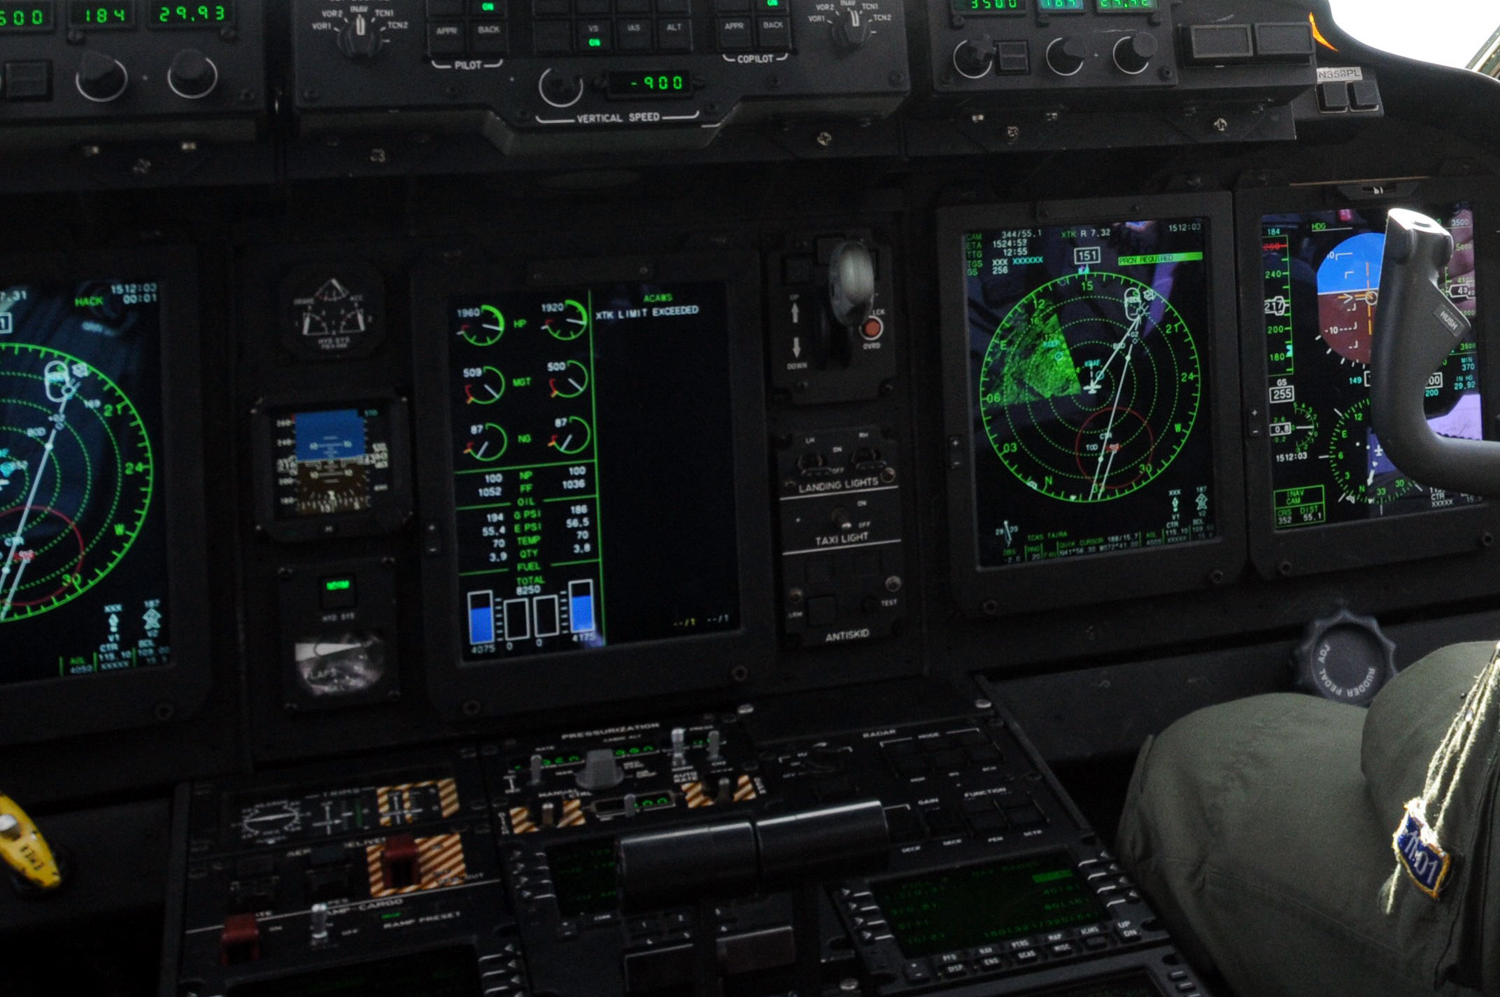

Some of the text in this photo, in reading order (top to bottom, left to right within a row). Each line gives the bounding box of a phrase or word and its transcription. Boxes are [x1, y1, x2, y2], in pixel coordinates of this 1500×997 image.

[86, 9, 125, 23] 184
[159, 6, 225, 22] 29.93
[737, 55, 773, 63] COPILOT
[454, 61, 482, 70] PILOT
[577, 112, 660, 123] VERTICAL SPEED
[1091, 229, 1110, 237] 7.32
[1079, 251, 1096, 260] 151
[1265, 270, 1281, 278] 240
[644, 294, 672, 303] ACAWS
[542, 303, 564, 312] 1920
[457, 309, 480, 318] 1960
[595, 305, 699, 320] XTK LIMIT EXCEEDED
[514, 319, 526, 328] HP
[1440, 310, 1459, 331] HUSH
[1267, 326, 1284, 334] 200
[1270, 353, 1285, 361] 180
[547, 362, 566, 372] 500
[463, 368, 482, 378] 509
[513, 377, 531, 387] MGT
[1454, 381, 1475, 390] 29.92
[1274, 390, 1292, 399] 255
[518, 434, 531, 443] NG
[1276, 452, 1307, 462] 1512:03
[799, 477, 879, 493] LANDING LIGHTS
[518, 497, 535, 506] OIL
[517, 536, 540, 546] TEMP
[816, 532, 869, 546] TAXI LIGHT
[517, 562, 541, 571] FUEL
[517, 576, 545, 585] TOTAL
[516, 585, 541, 595] 8250
[881, 599, 897, 607] TEST
[825, 629, 869, 642] ANTISKID
[1318, 644, 1376, 697] RUDDER PEDAL ADJ
[561, 722, 660, 740] PRESSURIZATION
[863, 729, 896, 738] RADAR
[964, 787, 1006, 798] FUNCTION
[419, 911, 461, 923] PRESET
